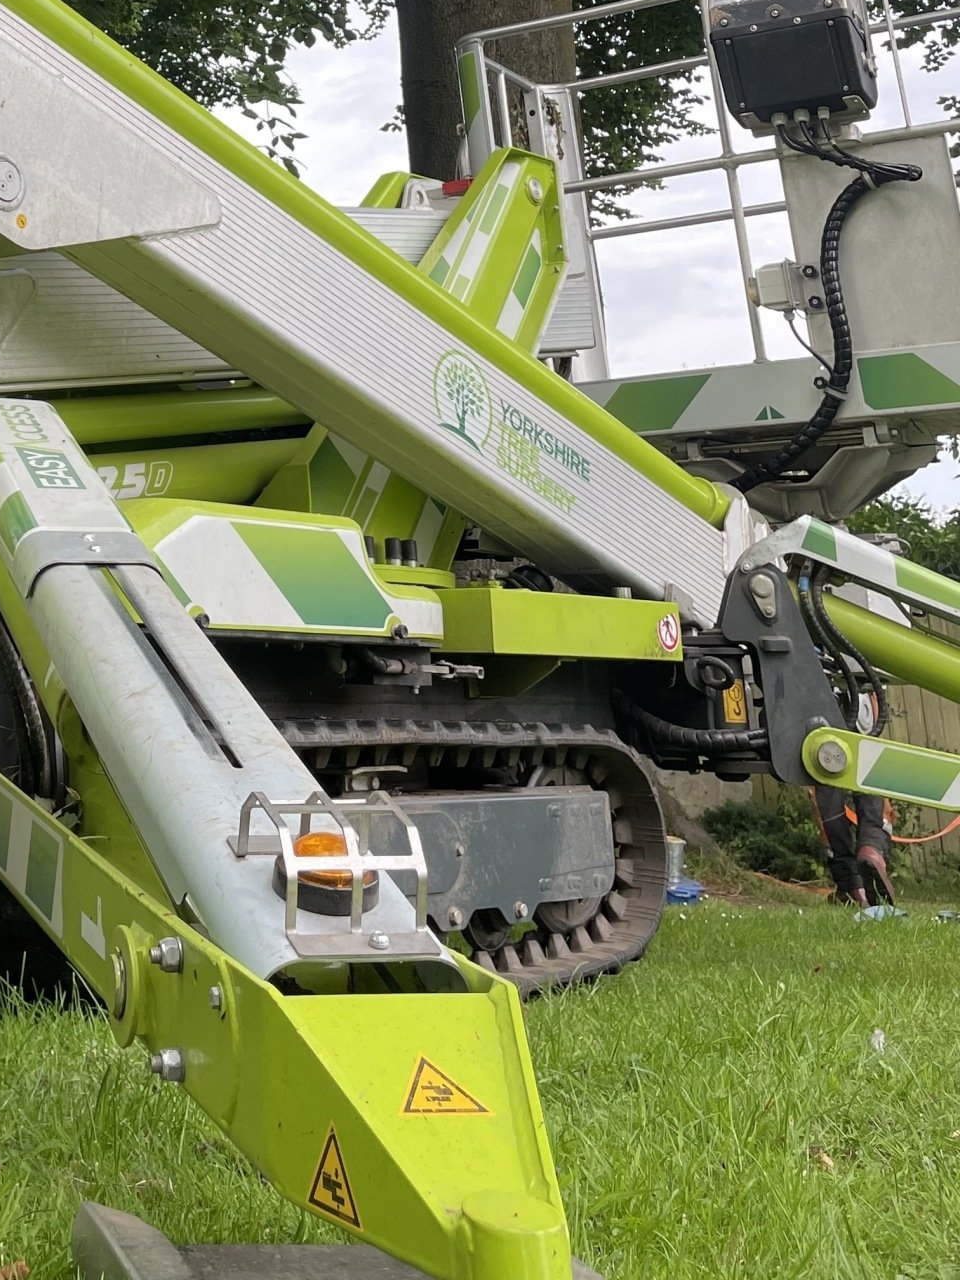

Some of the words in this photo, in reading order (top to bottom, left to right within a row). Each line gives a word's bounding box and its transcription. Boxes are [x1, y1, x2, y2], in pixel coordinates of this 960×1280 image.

[26, 450, 78, 489] EASY
[497, 420, 541, 466] TREE
[500, 399, 590, 483] YORKSHIRE
[496, 445, 577, 514] SURGERY
